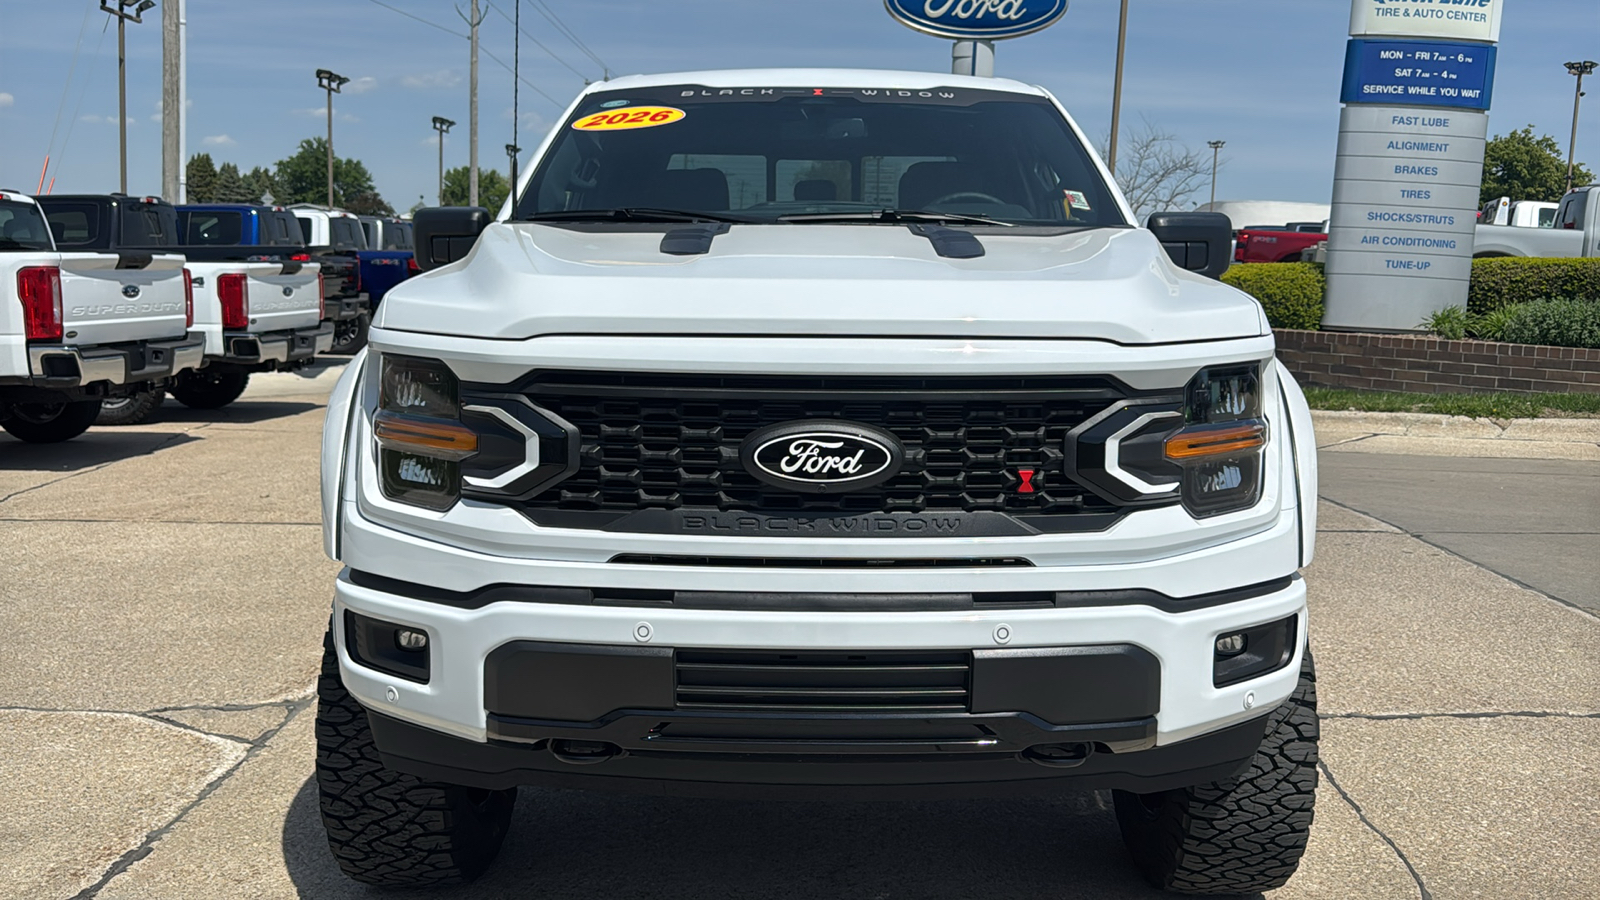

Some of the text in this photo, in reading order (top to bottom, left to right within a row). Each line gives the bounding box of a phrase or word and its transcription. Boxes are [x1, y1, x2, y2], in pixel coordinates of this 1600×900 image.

[1375, 7, 1487, 22] TIRE & AUTO CENTER
[1380, 50, 1403, 60] MON
[1415, 51, 1430, 60] FRI
[1394, 68, 1413, 77] SAT
[680, 88, 955, 99] BLACK WIDOW
[1362, 84, 1480, 98] SERVICE WHILE YOU WAIT
[582, 110, 674, 128] 2026
[1391, 116, 1450, 127] FAST LUBE
[1387, 141, 1449, 152] ALIGNMENT
[1394, 165, 1438, 176] BRAKES
[1400, 189, 1431, 199] TIRES
[1367, 211, 1455, 225] SHOCKS/STRUTS
[1360, 235, 1456, 249] AIR CONDITIONING
[1385, 259, 1431, 270] TUNE-UP
[72, 302, 182, 316] SUPER DUTY
[780, 439, 865, 474] Ford
[682, 515, 961, 532] BLACK WIDOW
